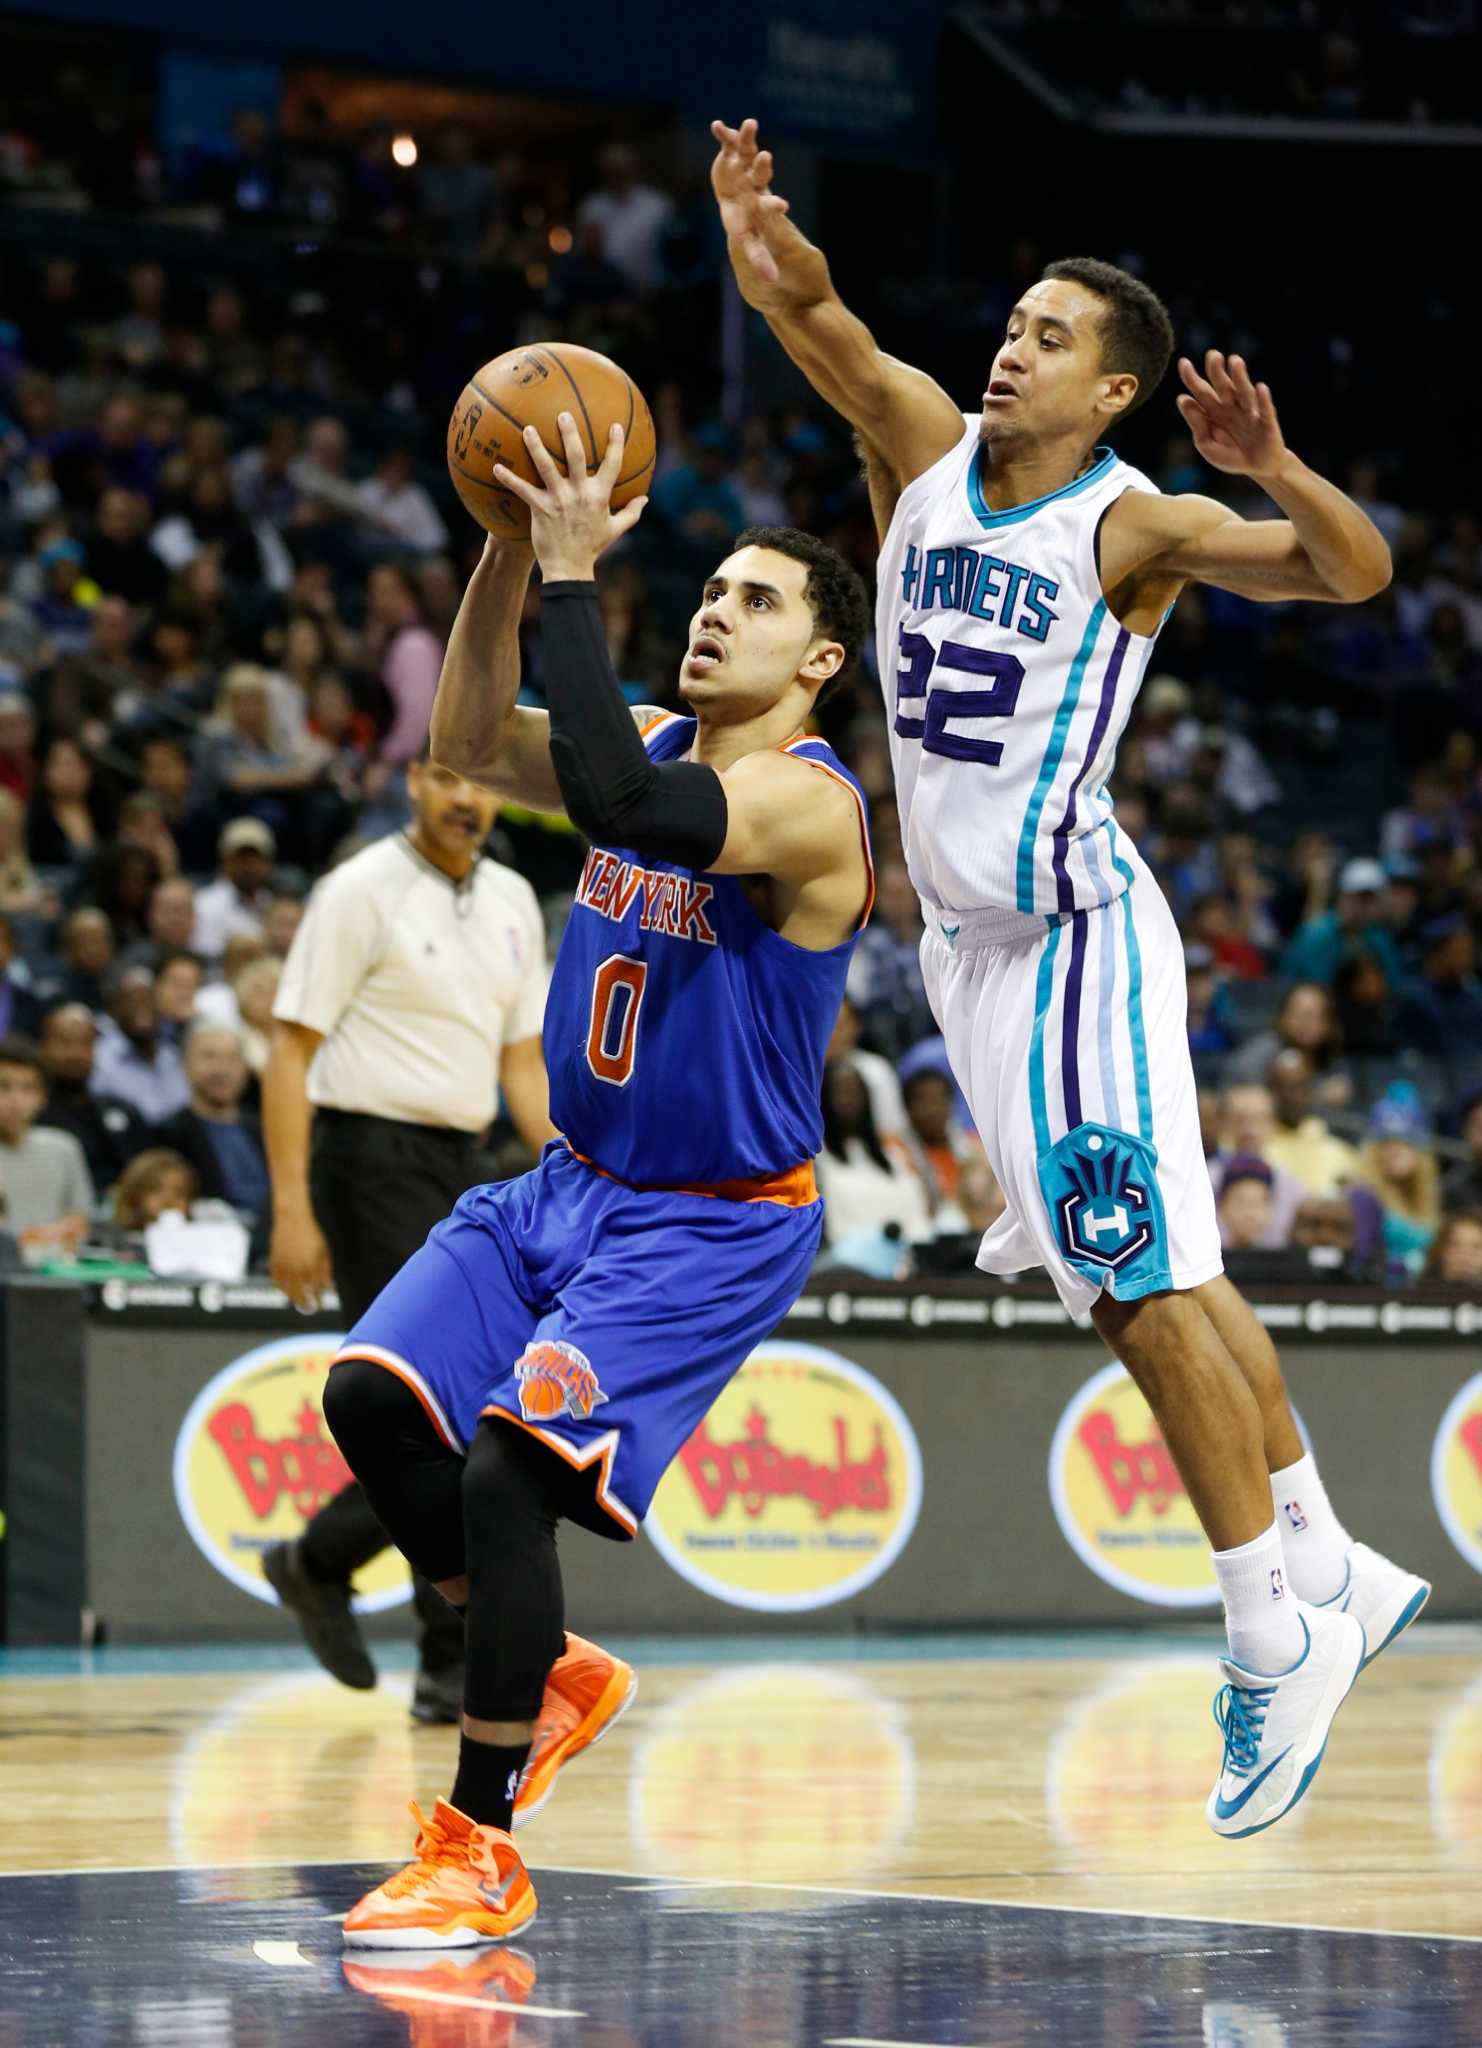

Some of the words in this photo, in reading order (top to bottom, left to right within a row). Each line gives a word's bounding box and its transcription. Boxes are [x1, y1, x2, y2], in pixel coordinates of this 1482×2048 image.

[901, 543, 1060, 643] HRNETS
[894, 621, 1026, 767] 22
[575, 846, 645, 923] NEW
[639, 869, 719, 947] YRK
[586, 953, 648, 1088] 0
